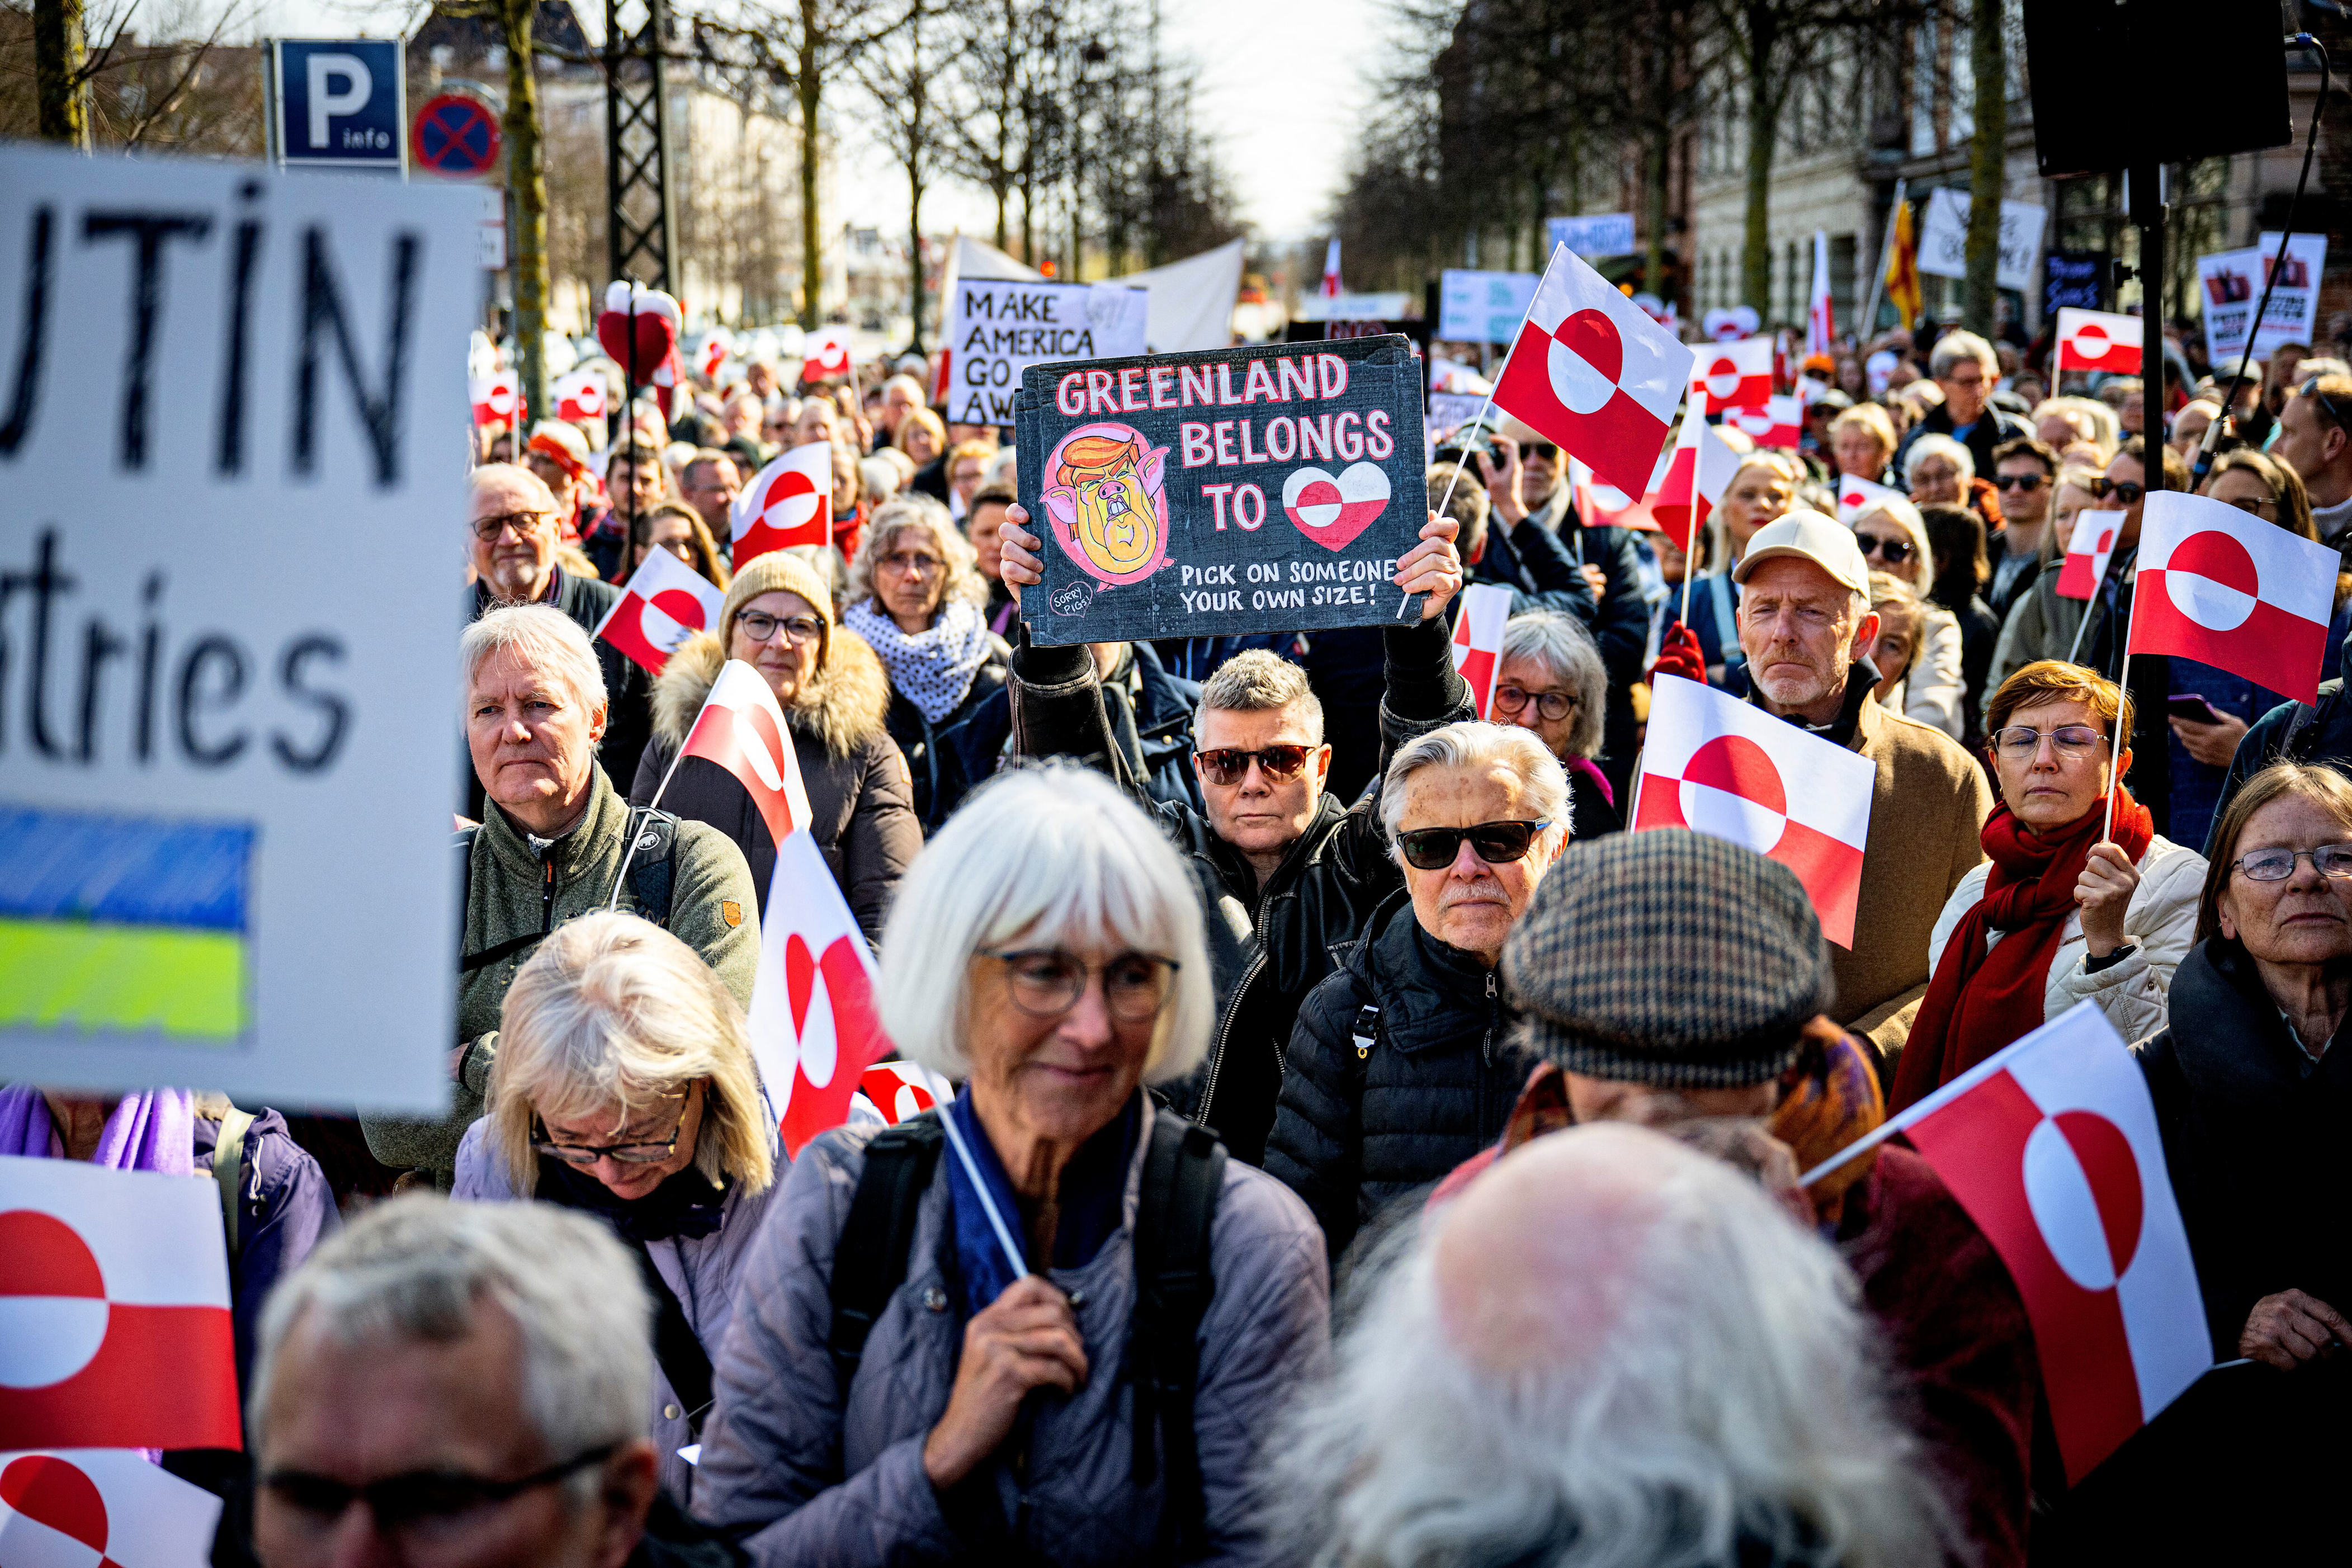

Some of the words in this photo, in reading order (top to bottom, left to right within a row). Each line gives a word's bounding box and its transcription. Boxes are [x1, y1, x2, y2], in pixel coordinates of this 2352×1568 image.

[306, 53, 373, 149] P
[342, 126, 390, 150] info
[965, 290, 1060, 323] MAKE
[963, 325, 1094, 357] AMERICA
[965, 357, 1011, 387] GO
[1055, 353, 1348, 415] GREENLAND
[962, 391, 1014, 424] AW
[1180, 409, 1394, 468] BELONGS
[1202, 482, 1267, 531] TO
[1181, 564, 1236, 586] PICK
[1246, 563, 1280, 583] ON
[1289, 559, 1398, 583] SOMEONE
[1054, 587, 1082, 607] SORRY
[1063, 594, 1092, 615] PIGS!
[1179, 590, 1244, 614] YOUR
[1251, 589, 1305, 611] OWN
[1311, 583, 1376, 606] SIZE!
[0, 523, 355, 777] tries
